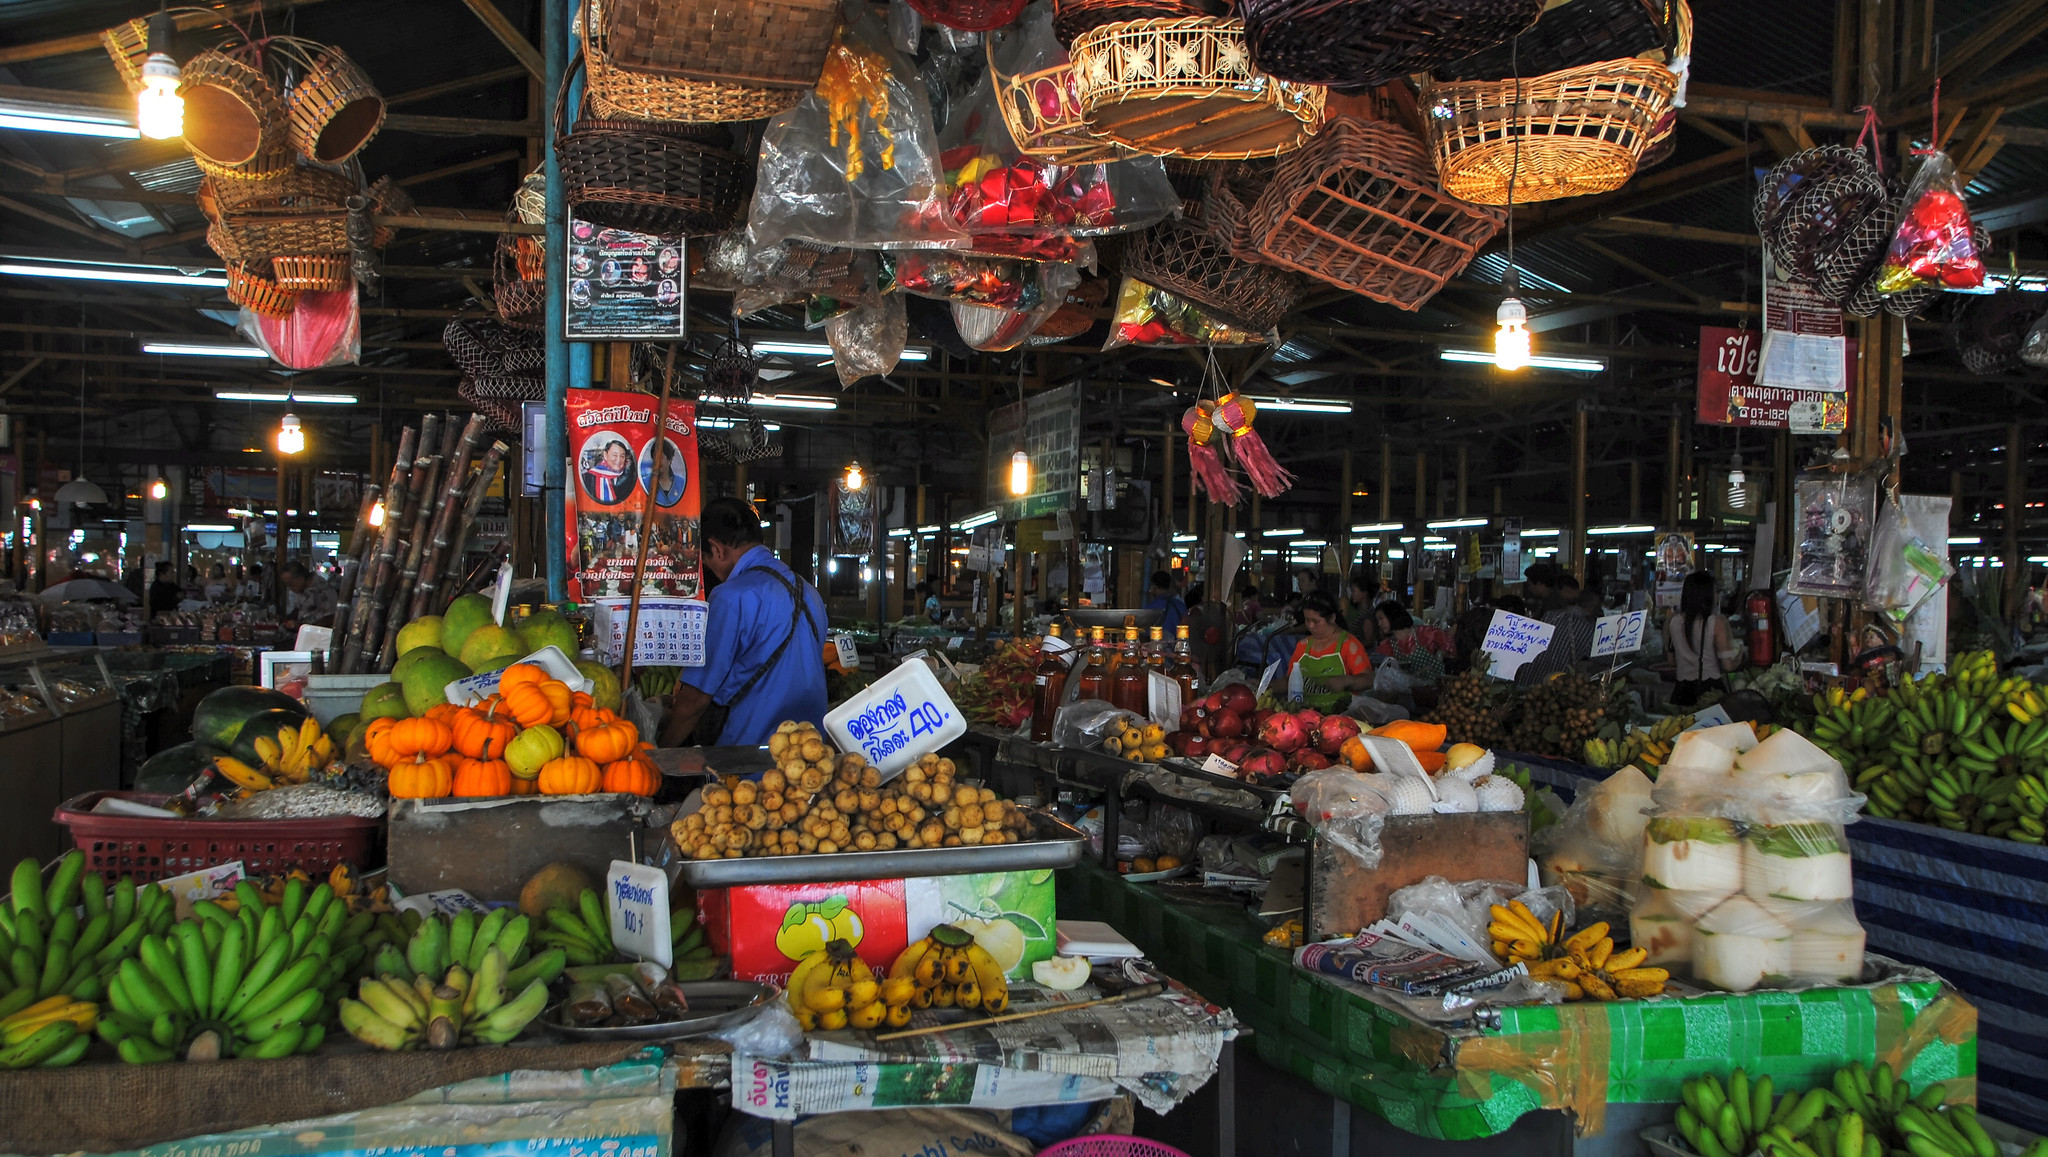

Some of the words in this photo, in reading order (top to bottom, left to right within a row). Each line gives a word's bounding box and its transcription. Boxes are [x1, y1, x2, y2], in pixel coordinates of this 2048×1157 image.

[1616, 612, 1642, 641] 25
[840, 637, 854, 652] 20
[847, 687, 907, 740] ลองกอง
